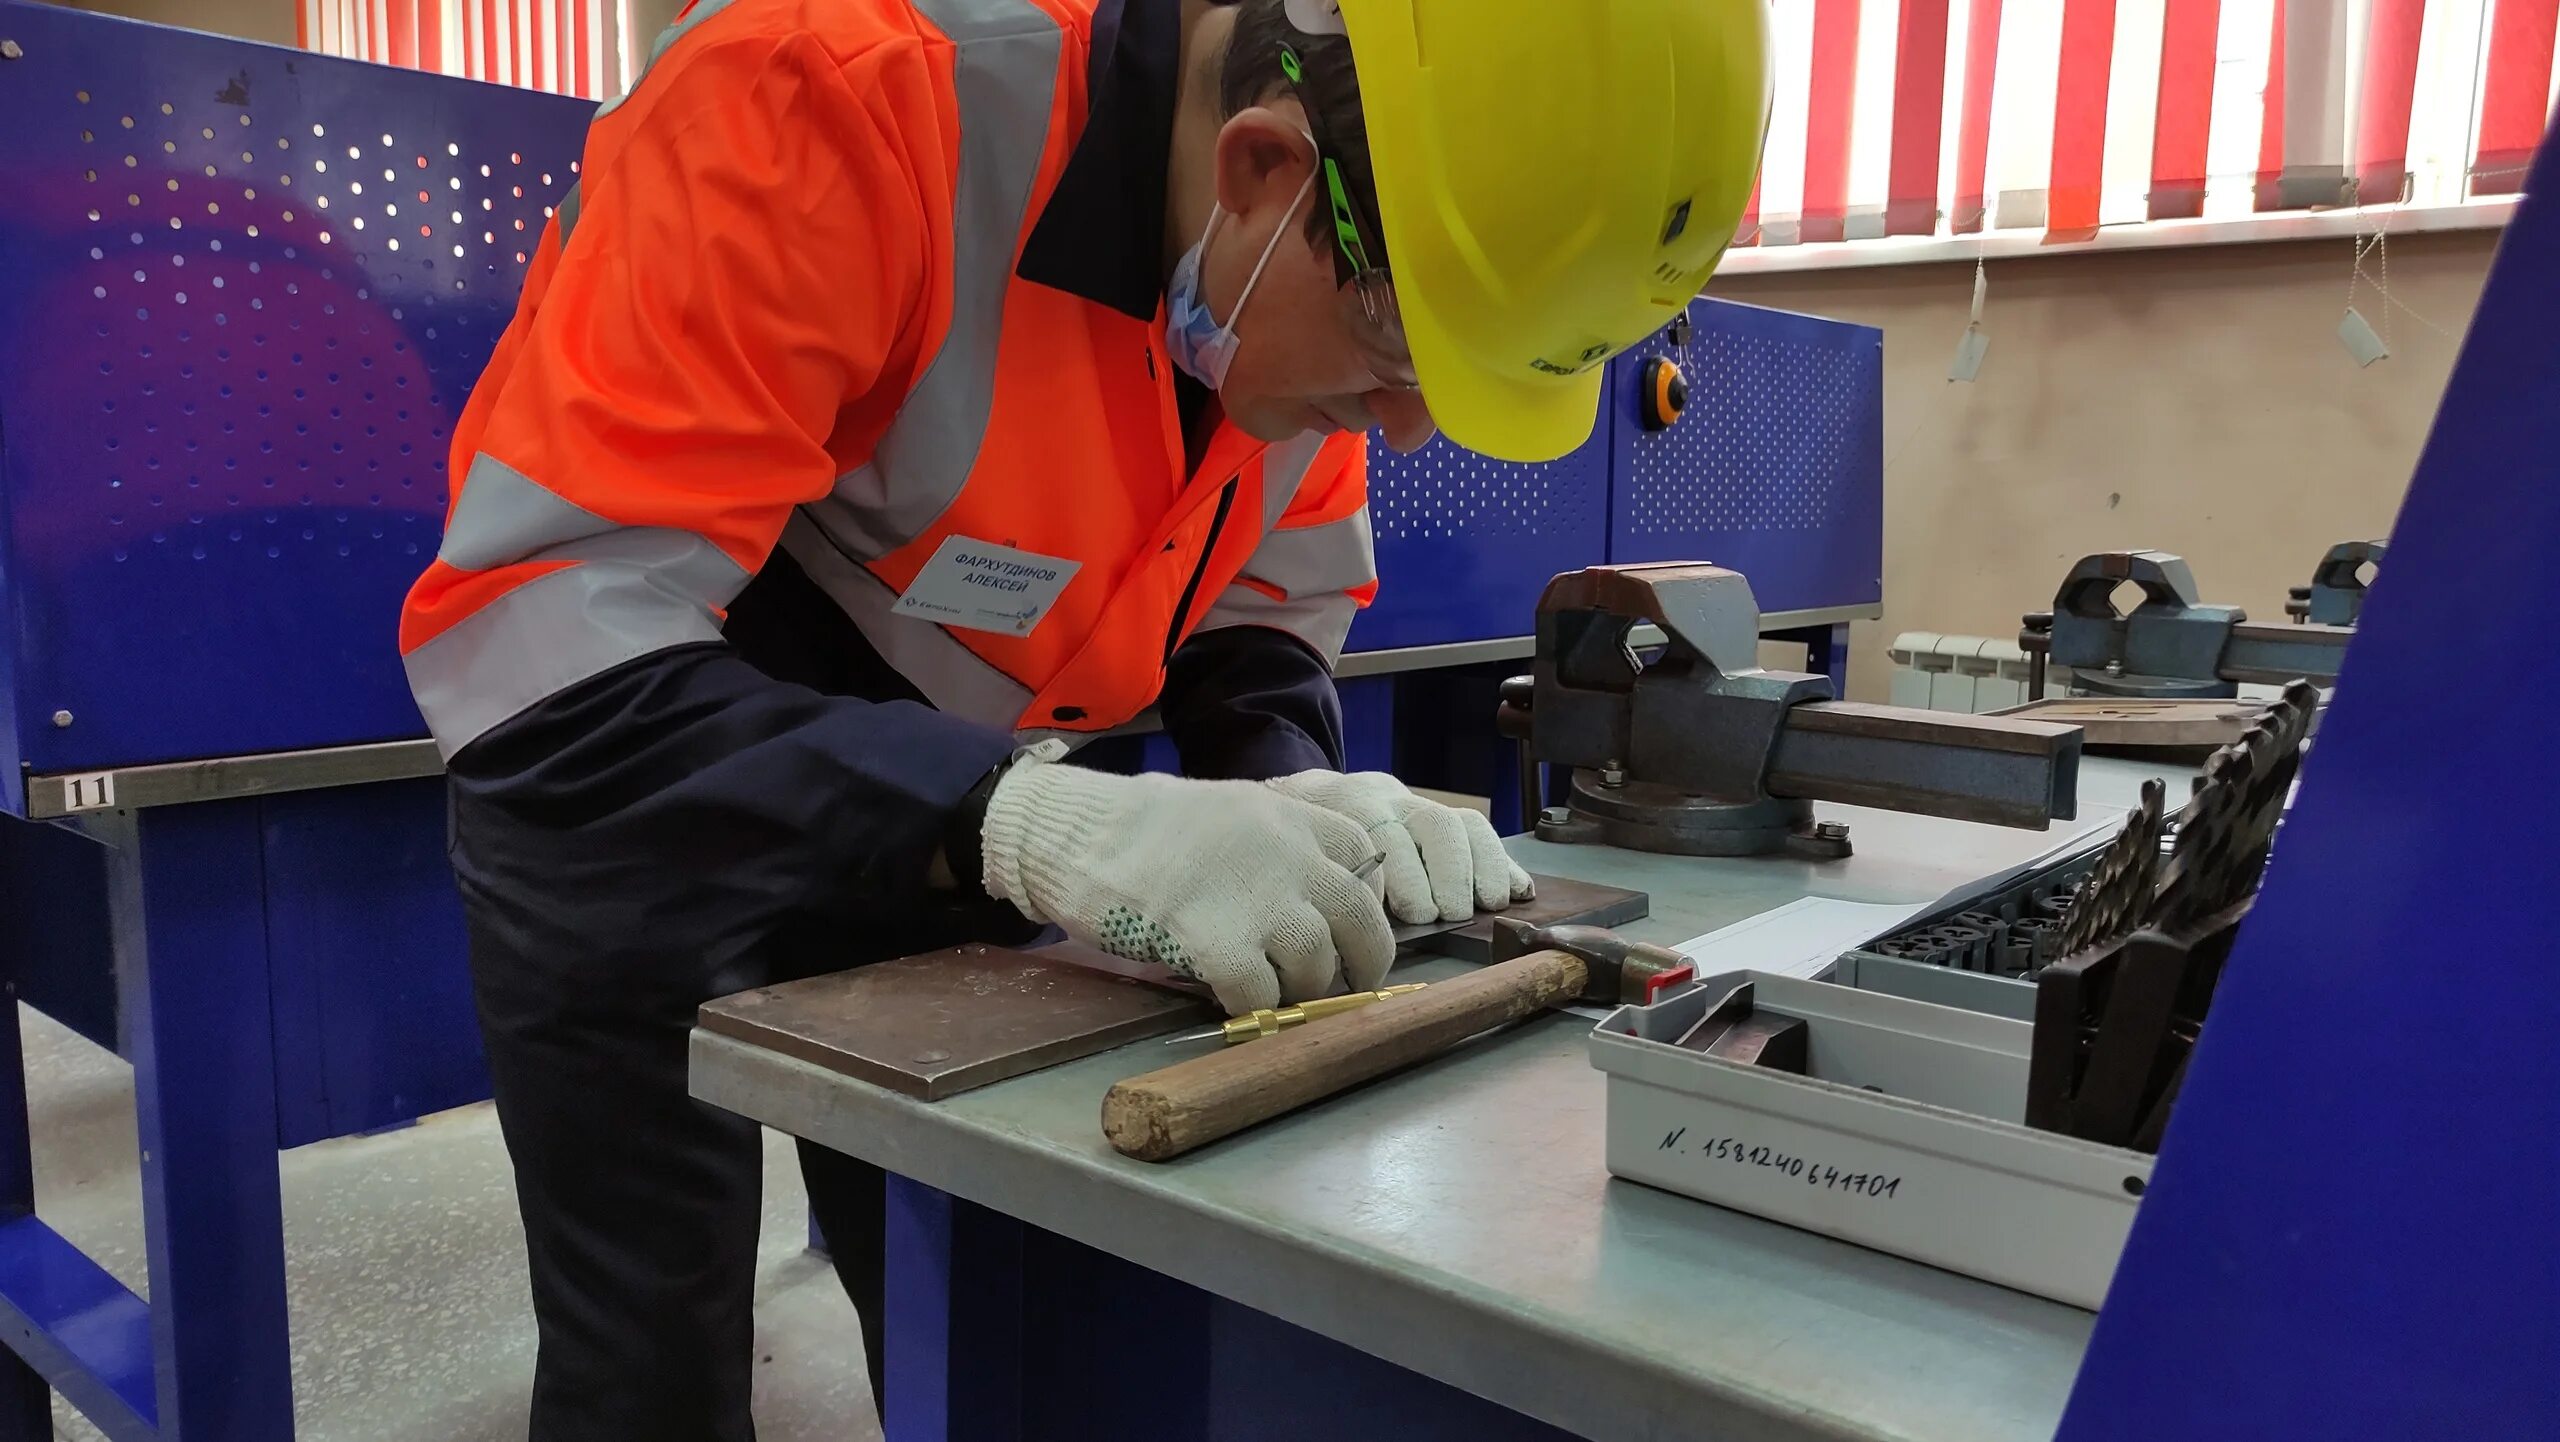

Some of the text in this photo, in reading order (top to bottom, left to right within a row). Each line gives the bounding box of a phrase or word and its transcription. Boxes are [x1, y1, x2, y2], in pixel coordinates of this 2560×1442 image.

[955, 553, 1057, 581] ФАРХУТДИНОВ
[962, 572, 1030, 593] АЛЕКСЕЙ
[69, 776, 109, 807] 11
[1702, 1138, 1901, 1198] 1581240641701
